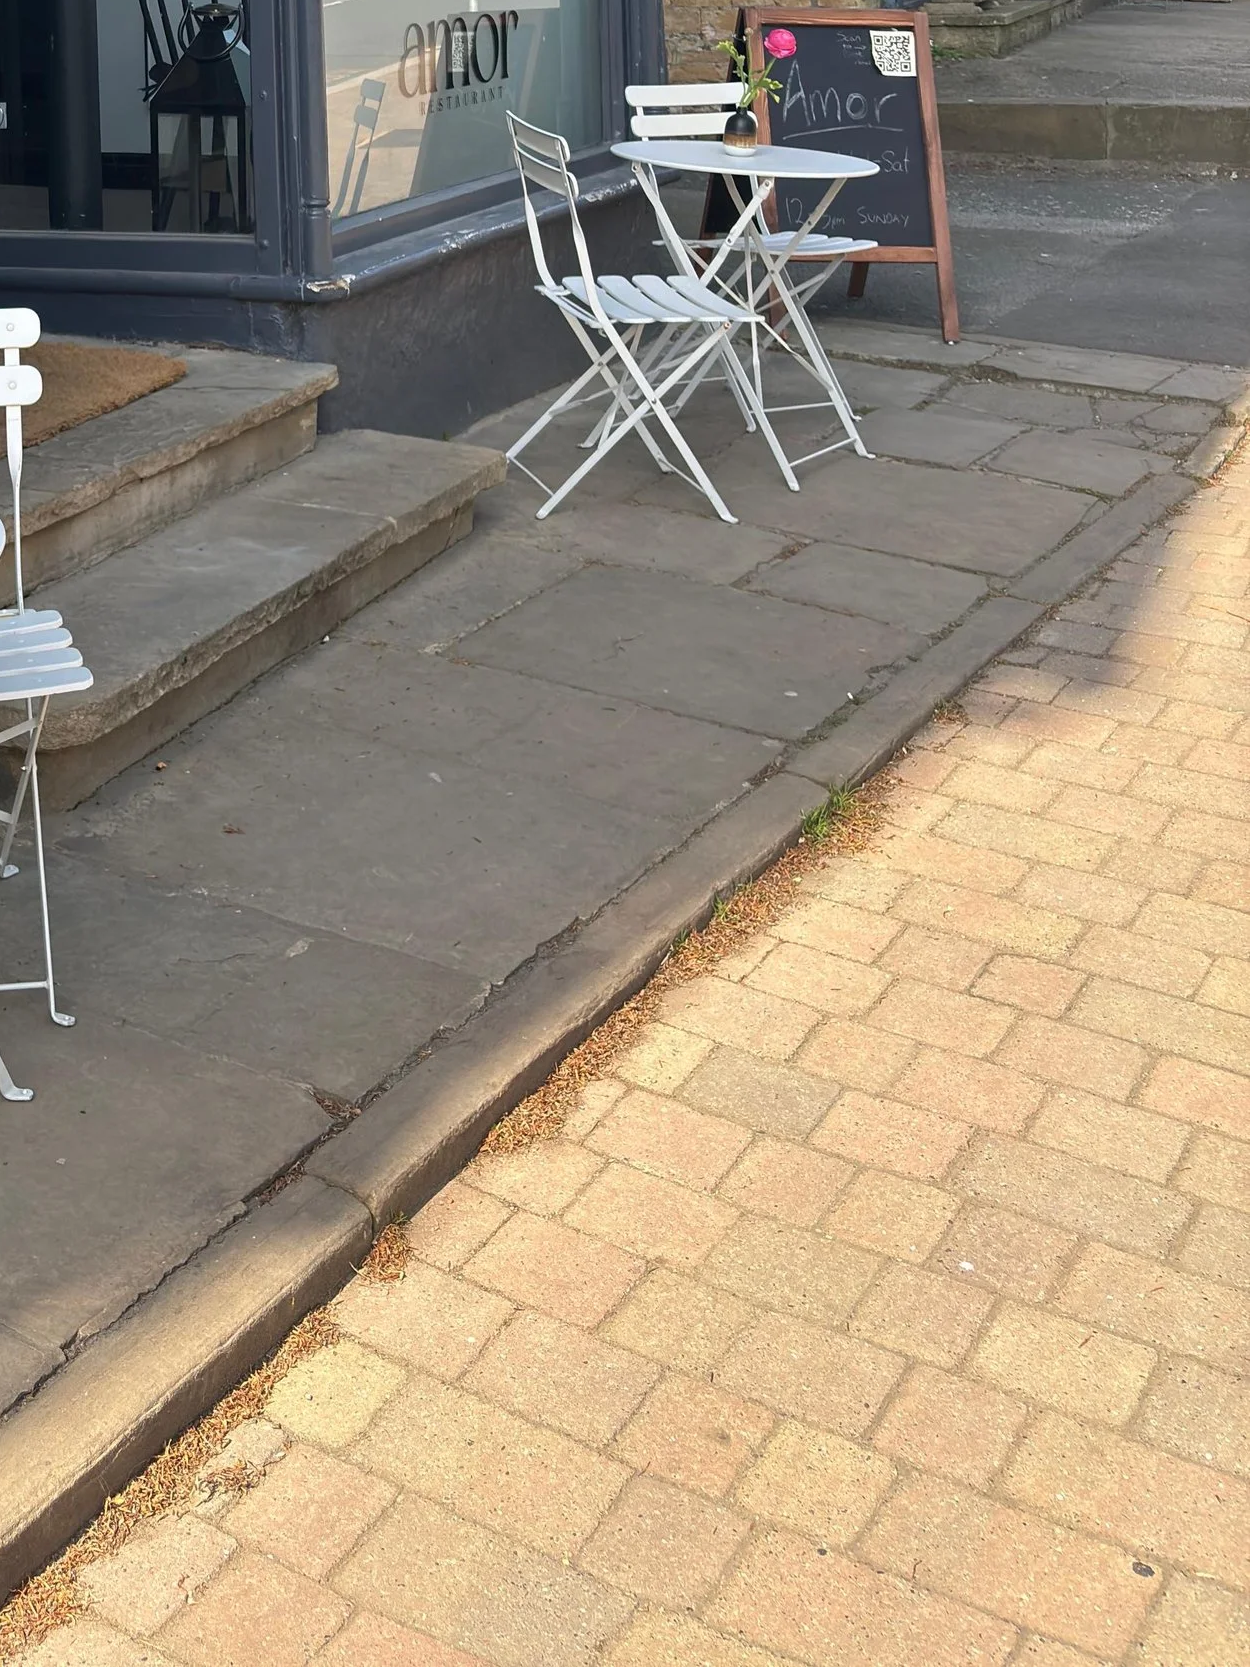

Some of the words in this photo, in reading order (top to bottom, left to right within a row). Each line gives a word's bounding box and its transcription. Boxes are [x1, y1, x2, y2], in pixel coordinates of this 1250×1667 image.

[398, 10, 519, 98] amor
[419, 86, 504, 117] RESTAURANT
[782, 59, 897, 126] Amor
[785, 197, 805, 224] 12
[857, 206, 910, 228] SUNDAY
